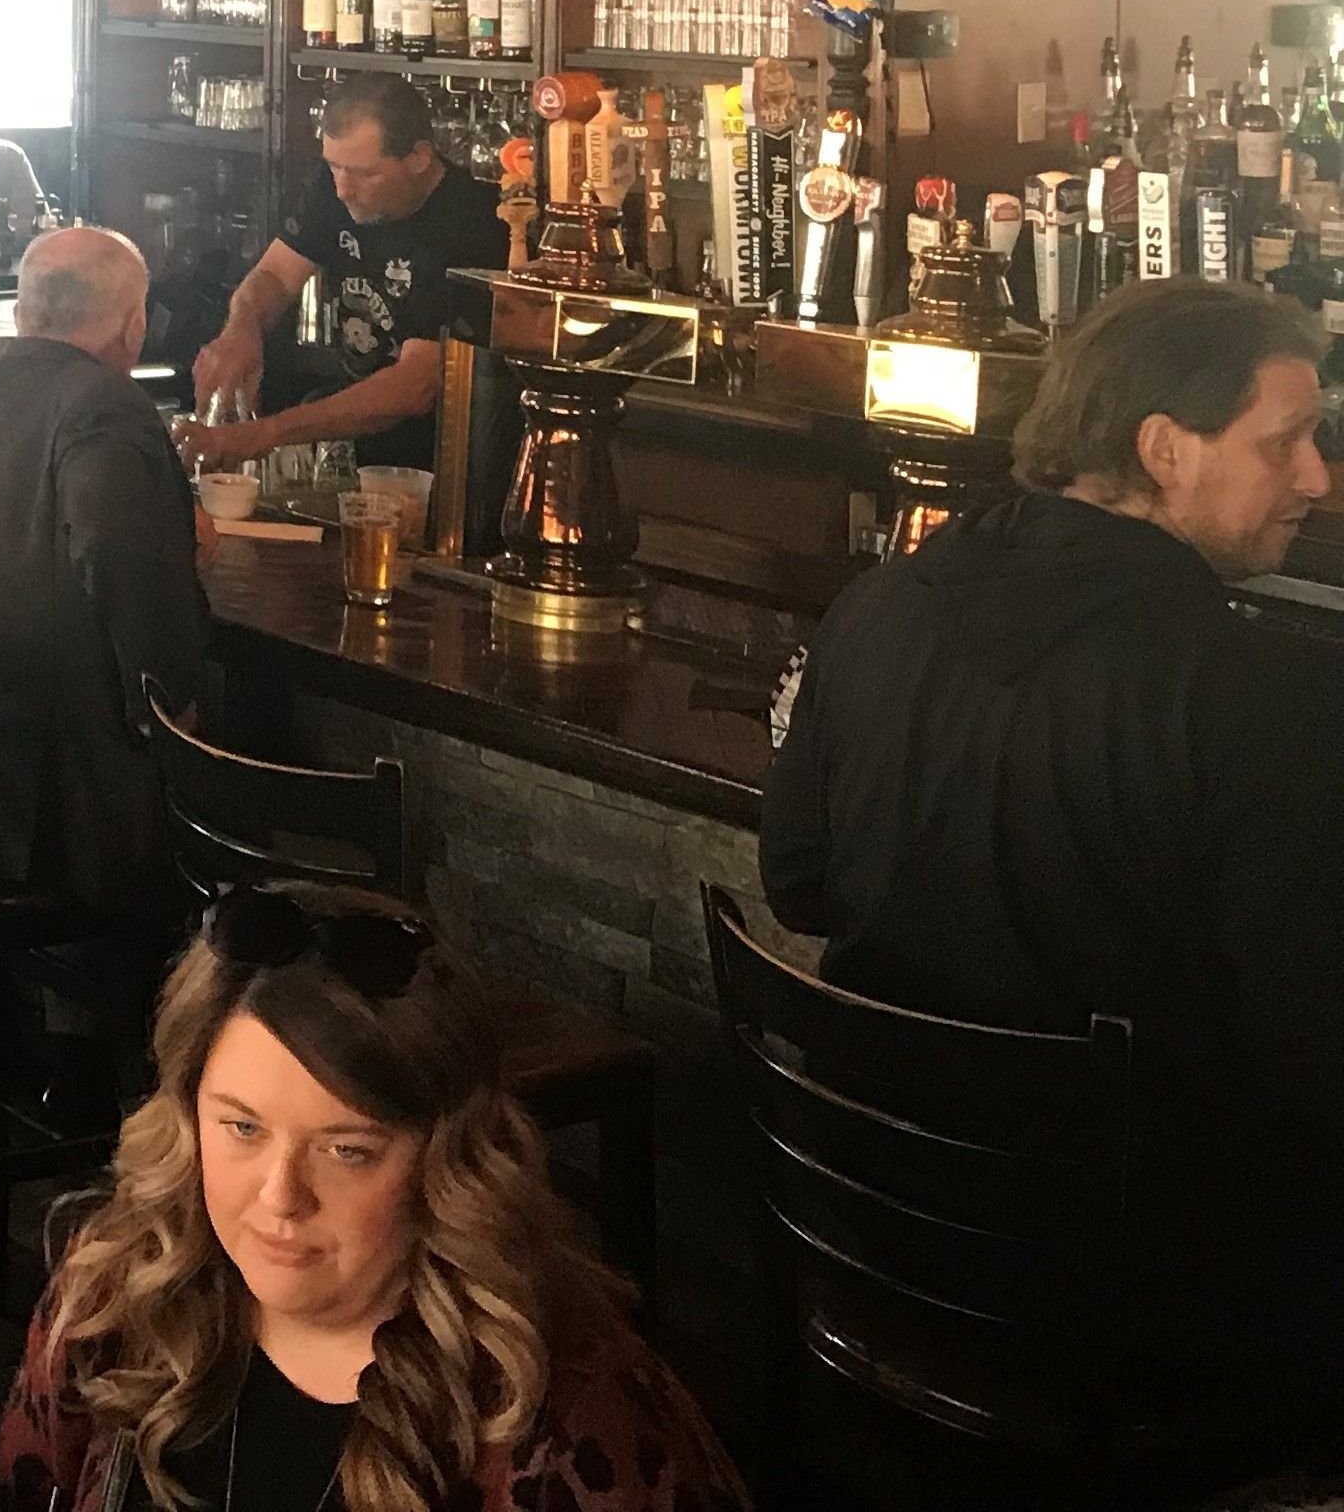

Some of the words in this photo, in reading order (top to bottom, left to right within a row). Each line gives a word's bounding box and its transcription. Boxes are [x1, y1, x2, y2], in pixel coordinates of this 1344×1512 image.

[590, 130, 603, 184] ALLAGASH
[648, 168, 667, 233] IPA
[752, 236, 760, 268] SINCE
[1145, 225, 1163, 276] ERS
[1203, 207, 1227, 283] LIGHT
